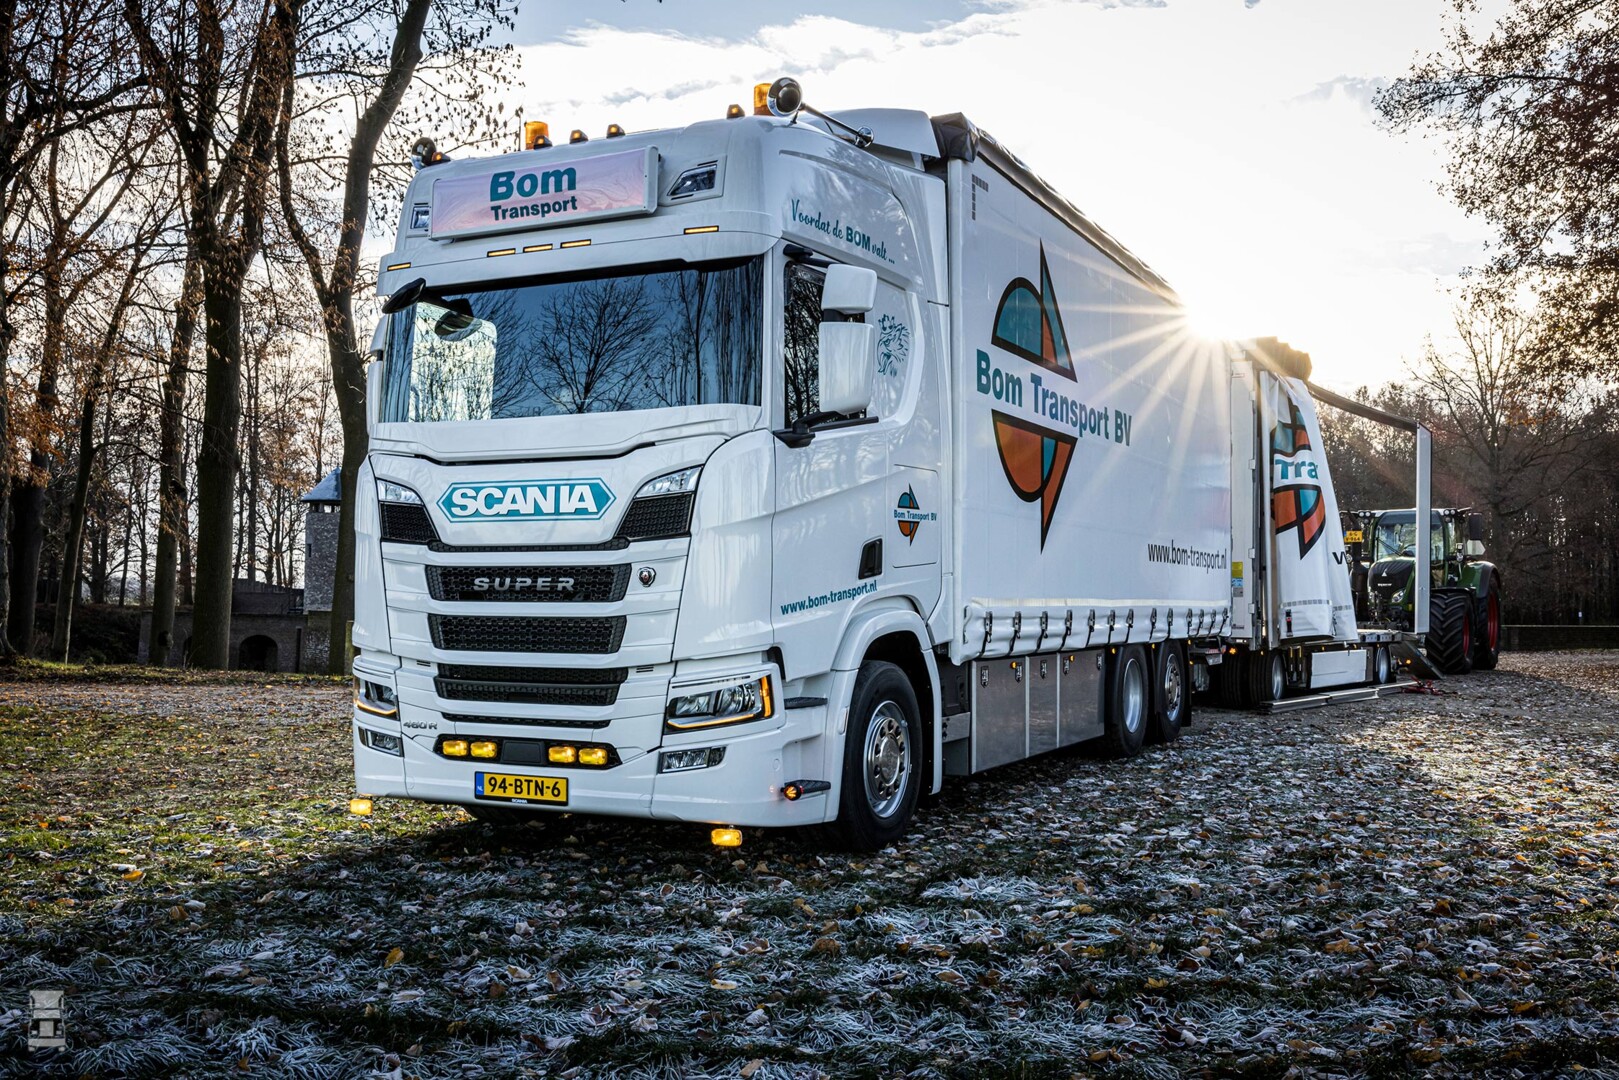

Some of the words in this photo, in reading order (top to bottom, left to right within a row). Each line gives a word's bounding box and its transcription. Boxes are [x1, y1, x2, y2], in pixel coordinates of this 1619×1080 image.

[490, 167, 576, 202] Bom
[491, 196, 577, 221] Transport
[791, 199, 831, 235] Voordat
[832, 220, 843, 239] de
[846, 226, 871, 252] BOM
[976, 349, 1023, 408] Bom
[1031, 372, 1109, 438] Transport
[1114, 409, 1132, 447] BV
[1275, 459, 1319, 480] Tra
[450, 484, 598, 517] SCANIA
[893, 509, 906, 519] Bom
[907, 510, 930, 522] Transport
[931, 512, 937, 521] BV
[1147, 539, 1227, 574] www.bom-transport.nl
[473, 577, 575, 592] SUPER
[780, 580, 878, 615] www.bom-transport.nl
[428, 722, 438, 730] R
[488, 776, 561, 798] 94-BTN-6
